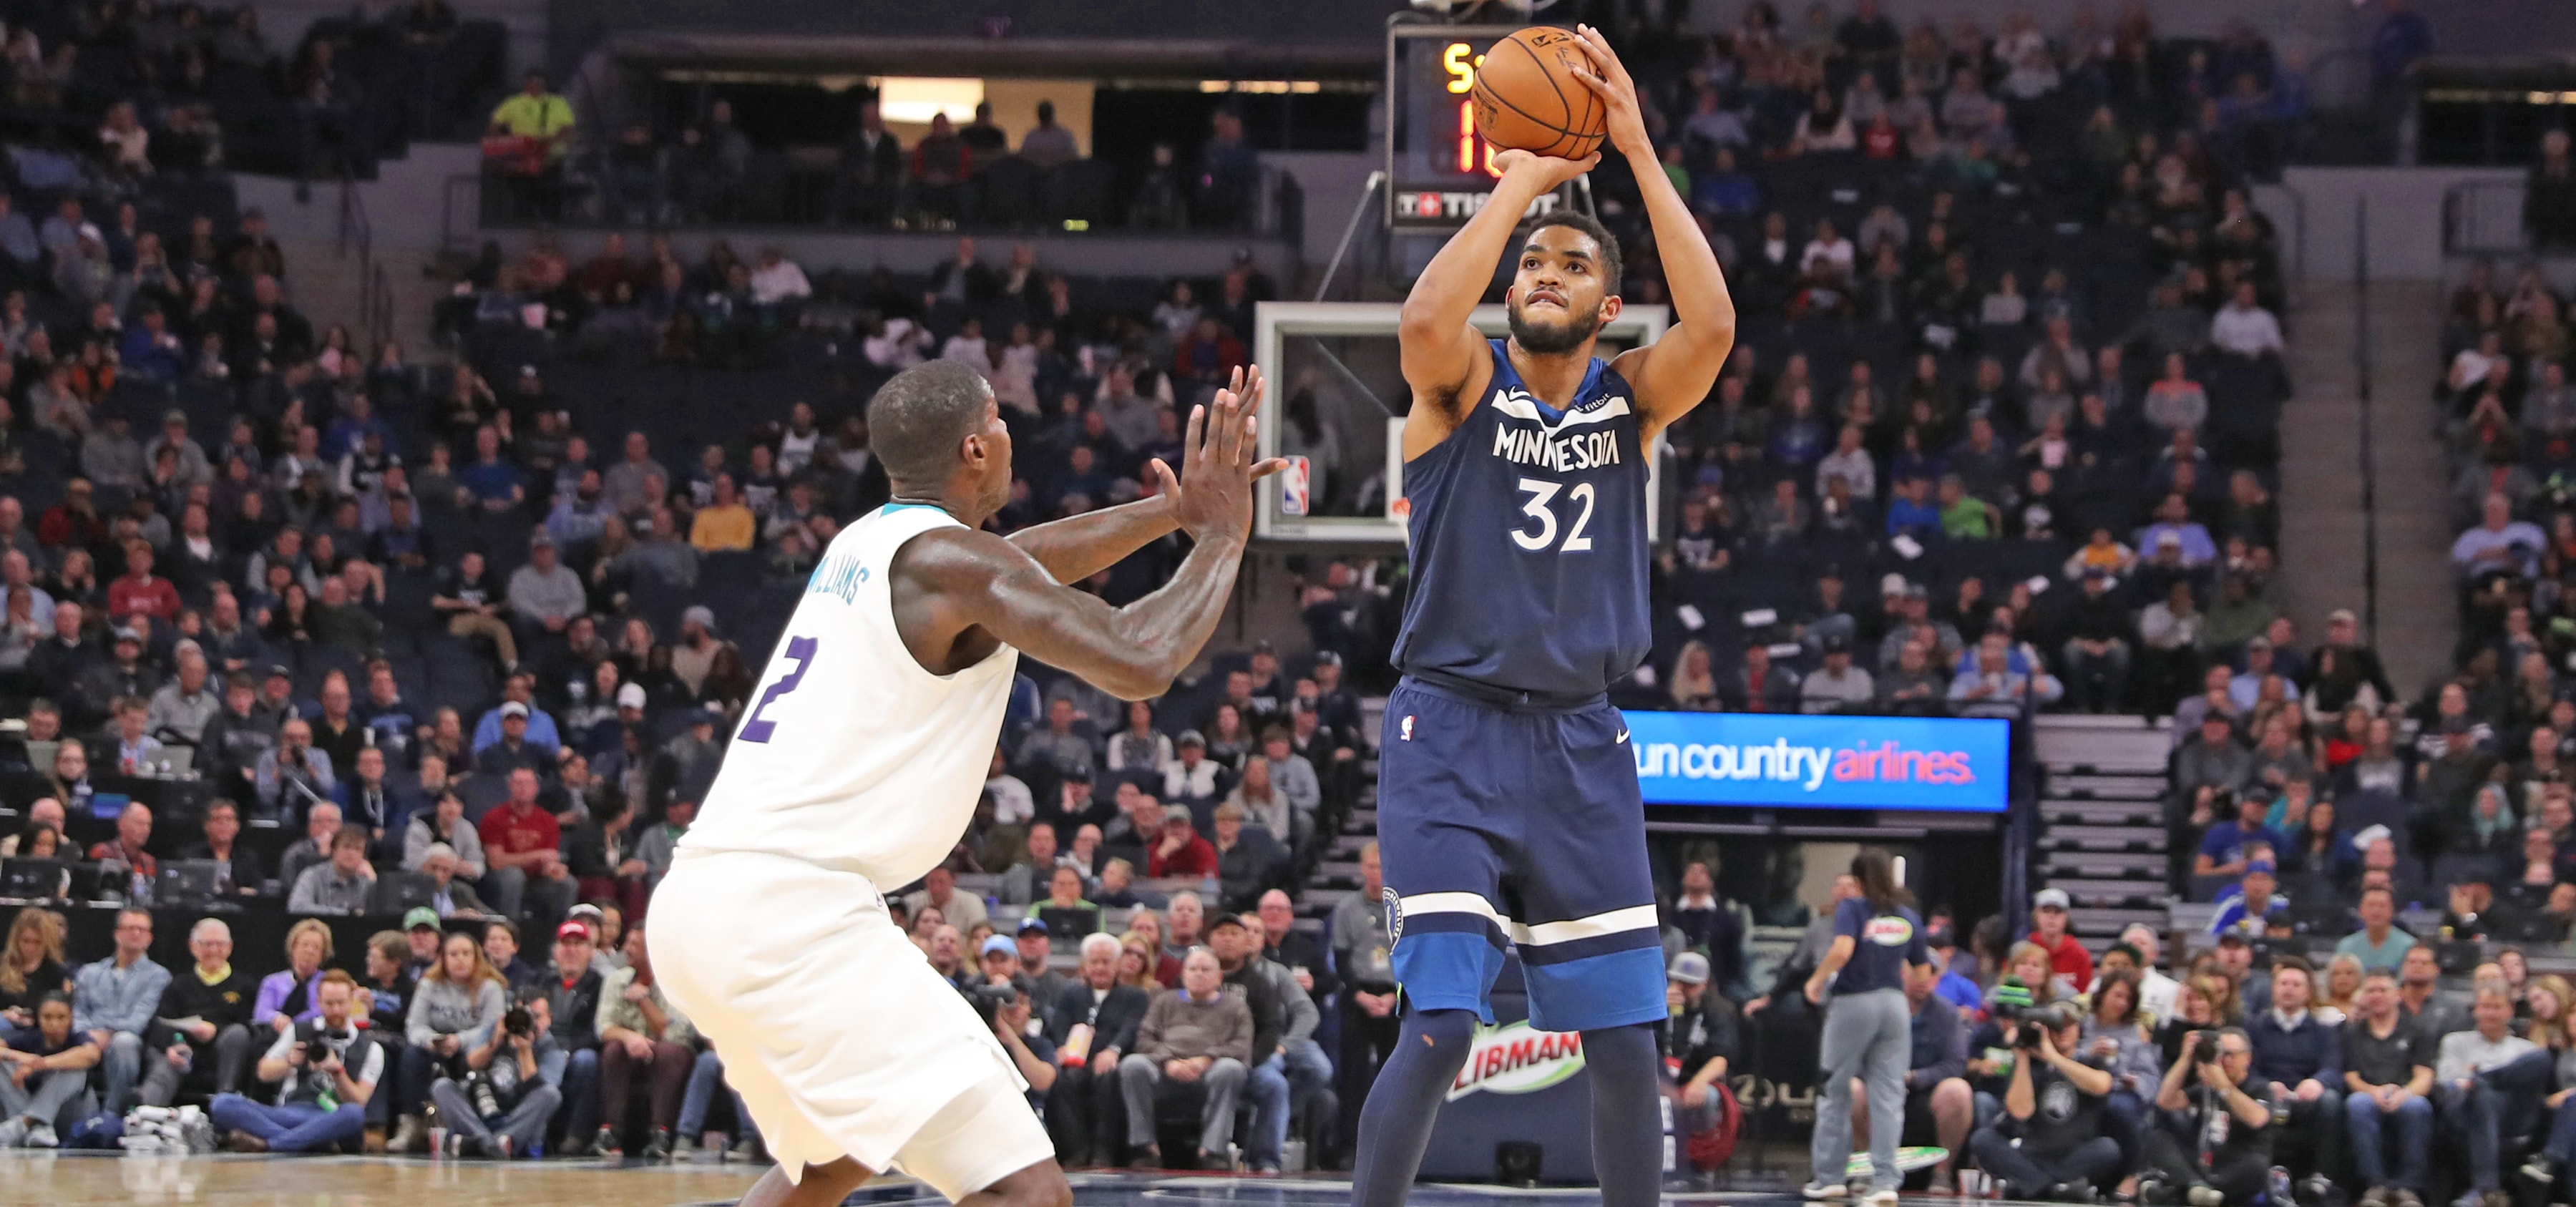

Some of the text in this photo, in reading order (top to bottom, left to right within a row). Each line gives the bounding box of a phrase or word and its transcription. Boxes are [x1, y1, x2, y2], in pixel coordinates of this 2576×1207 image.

[1585, 393, 1610, 411] fitbit
[1492, 422, 1621, 473] MINNESOTA
[1511, 477, 1596, 552] 32
[738, 635, 819, 743] 2
[1454, 1030, 1582, 1090] LIBMAN
